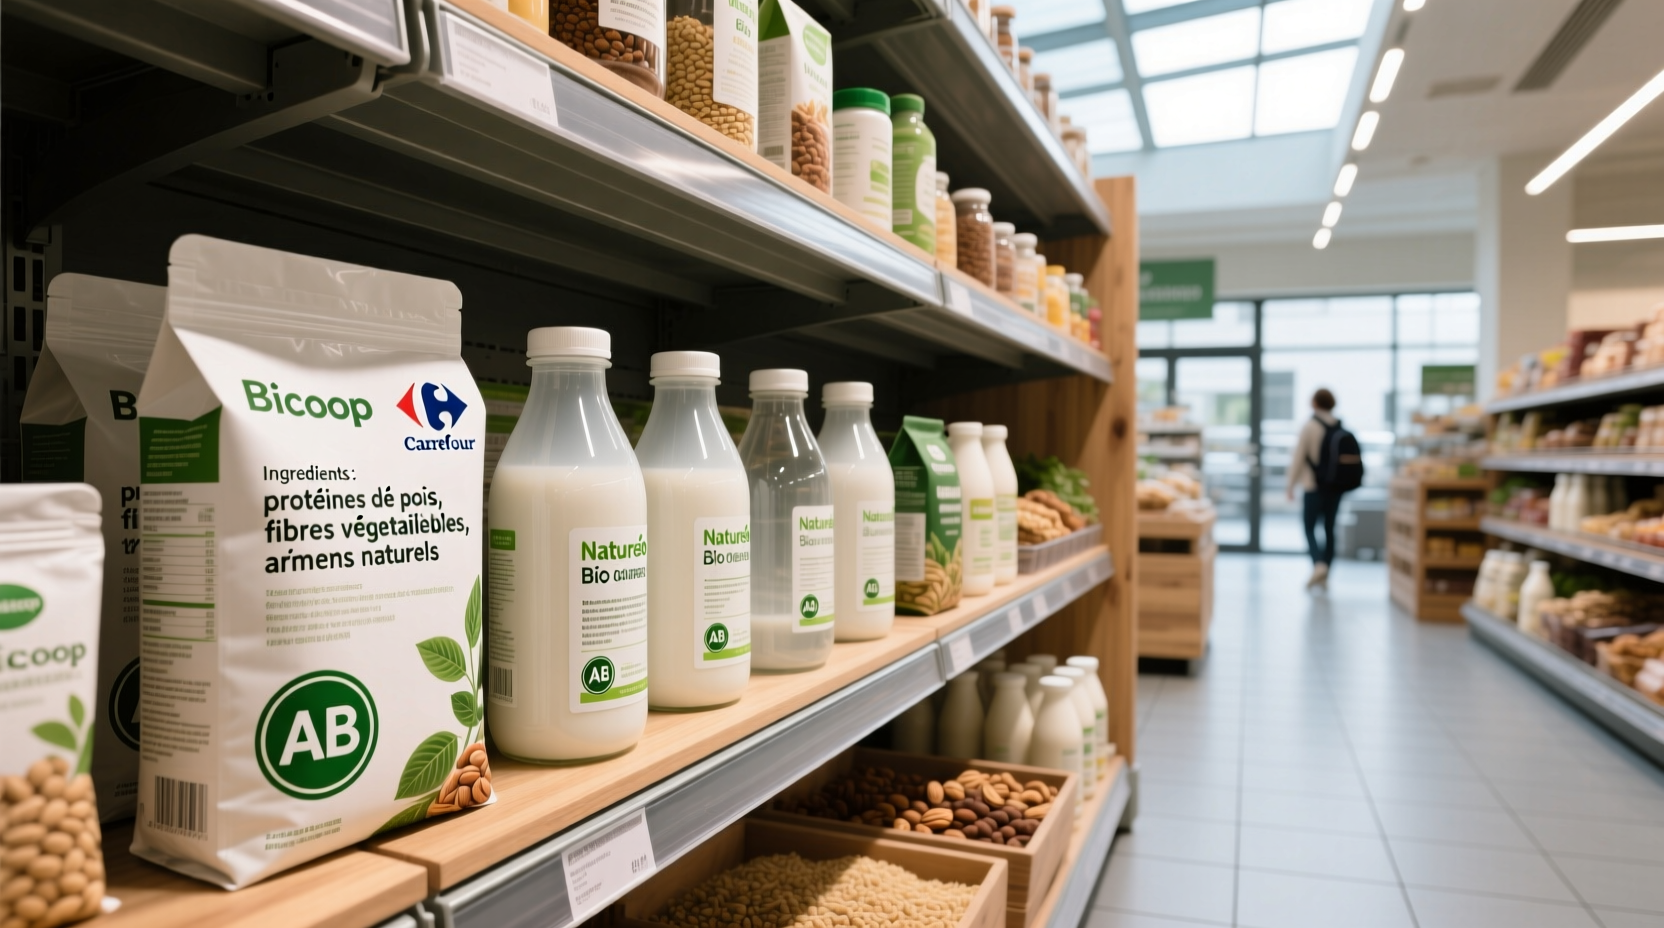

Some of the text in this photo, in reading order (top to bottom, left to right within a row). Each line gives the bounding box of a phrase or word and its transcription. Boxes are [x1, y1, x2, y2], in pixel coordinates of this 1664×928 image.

[241, 379, 373, 428] Bicoop
[404, 434, 476, 451] Carrefour
[263, 465, 357, 484] Ingredients:
[264, 486, 442, 517] protéines dé pois,
[264, 518, 334, 543] fibres
[361, 541, 439, 567] naturels
[581, 566, 610, 585] Bio
[709, 629, 725, 645] AB
[588, 665, 610, 685] AB
[279, 704, 361, 767] AB
